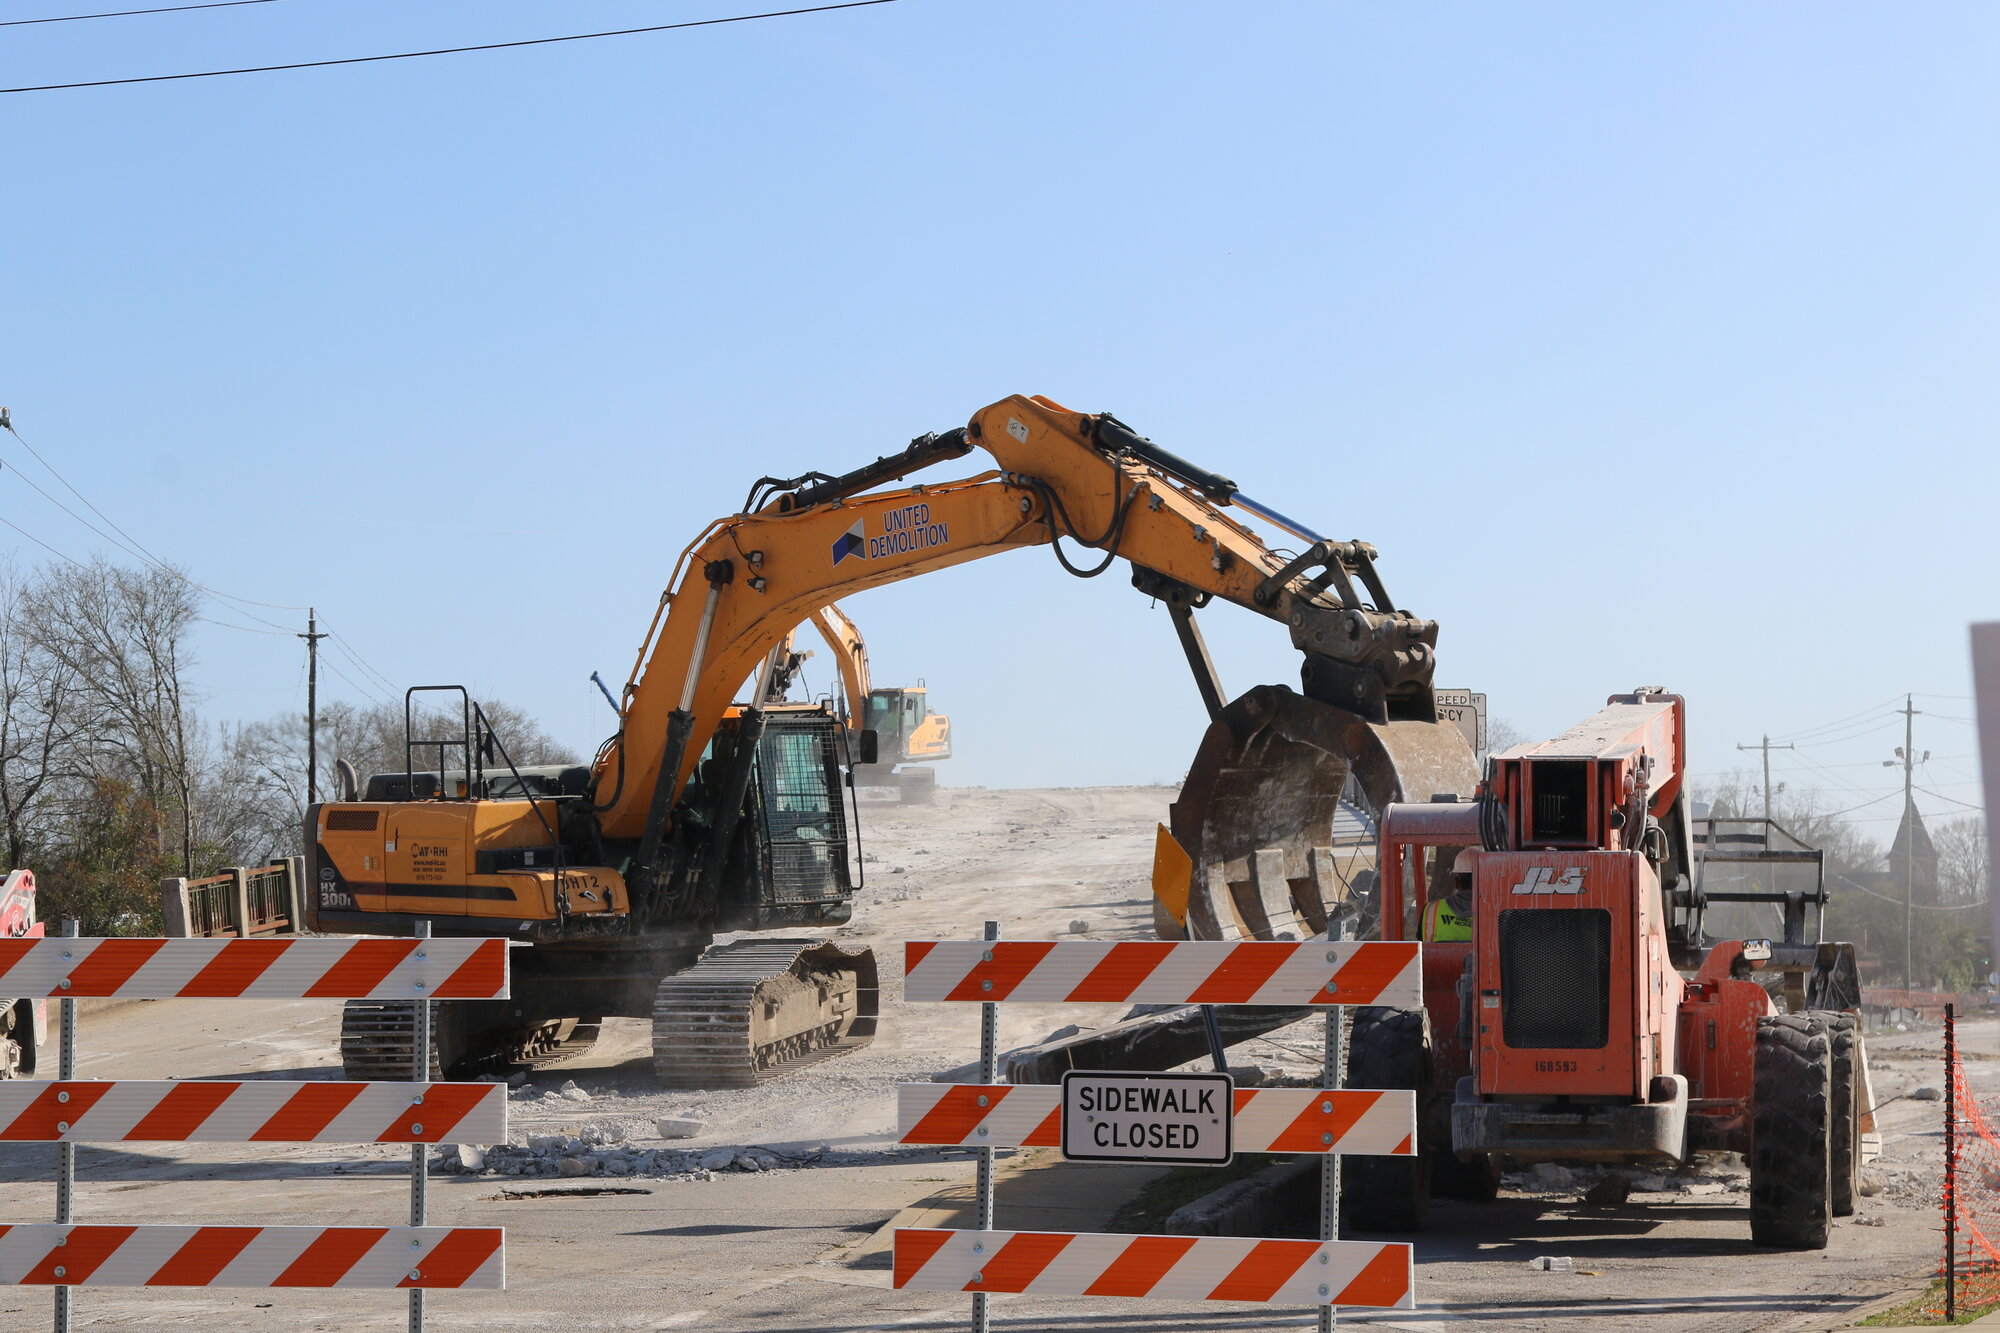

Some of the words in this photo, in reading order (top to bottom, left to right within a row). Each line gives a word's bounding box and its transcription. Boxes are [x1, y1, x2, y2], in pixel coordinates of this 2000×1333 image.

[883, 503, 930, 533] UNITED
[870, 522, 949, 559] DEMOLITION
[1436, 695, 1468, 705] PEED
[320, 882, 336, 892] HX
[1511, 866, 1589, 895] JLG
[1535, 1060, 1577, 1072] 168593
[1080, 1086, 1215, 1114] SIDEWALK
[1094, 1121, 1199, 1149] CLOSED
